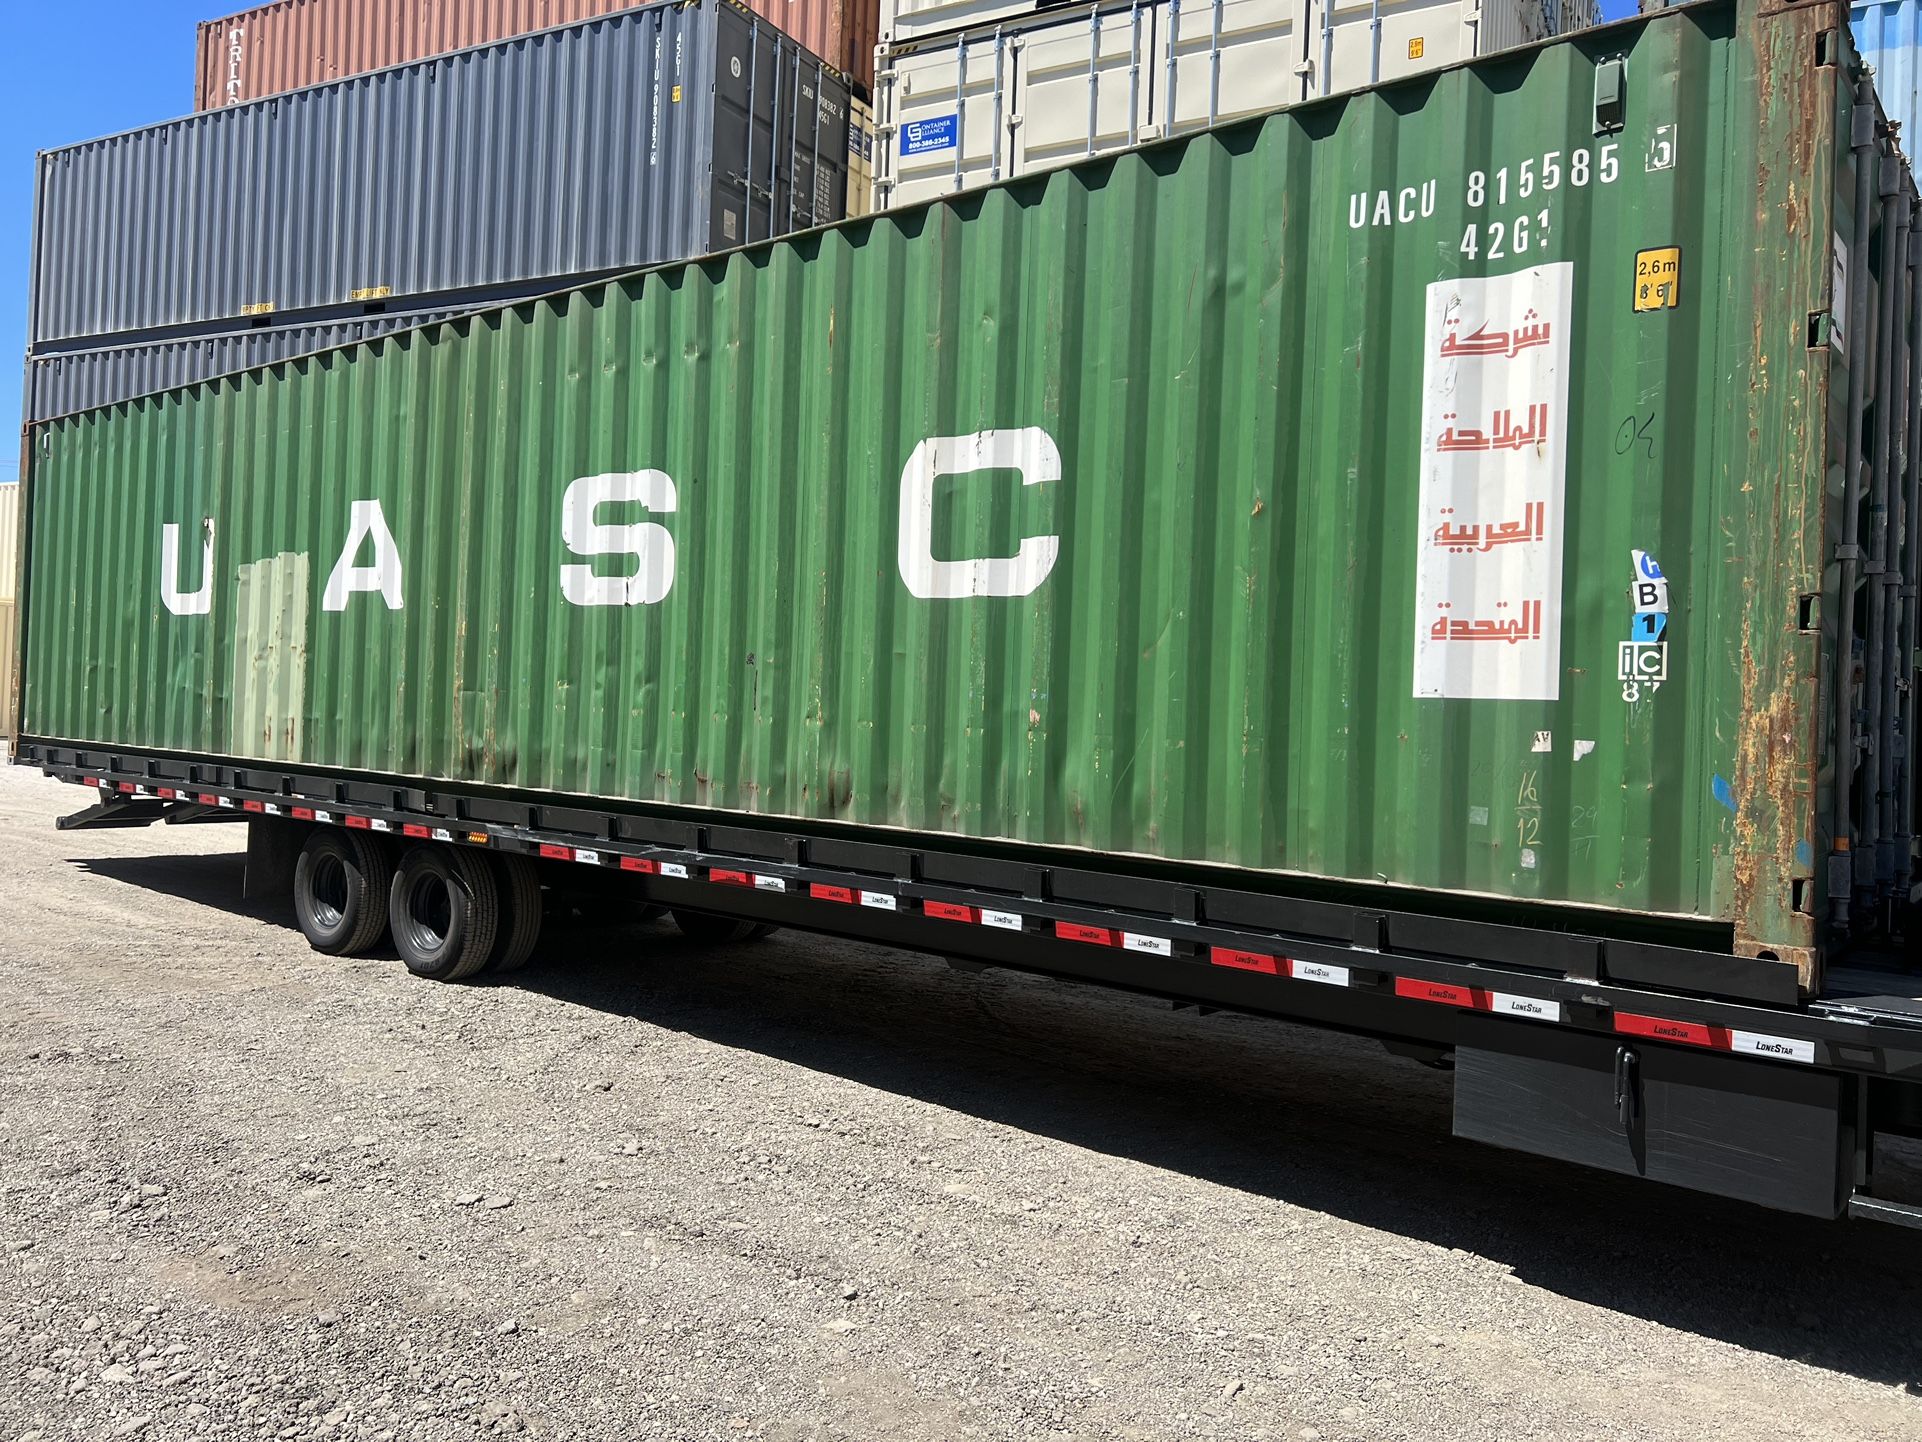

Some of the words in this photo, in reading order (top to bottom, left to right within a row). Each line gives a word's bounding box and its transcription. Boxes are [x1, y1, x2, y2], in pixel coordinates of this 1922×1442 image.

[651, 84, 659, 149] 908382
[1349, 179, 1436, 228] UACU
[1467, 143, 1619, 207] 815585
[1460, 208, 1551, 260] 42G1
[1440, 308, 1550, 358] شركة
[1436, 403, 1547, 452] الملاحة
[1433, 502, 1544, 553] العربية
[1639, 583, 1658, 606] B
[1431, 600, 1541, 644] المتحدة
[1642, 614, 1655, 633] 1
[1518, 817, 1544, 847] 12
